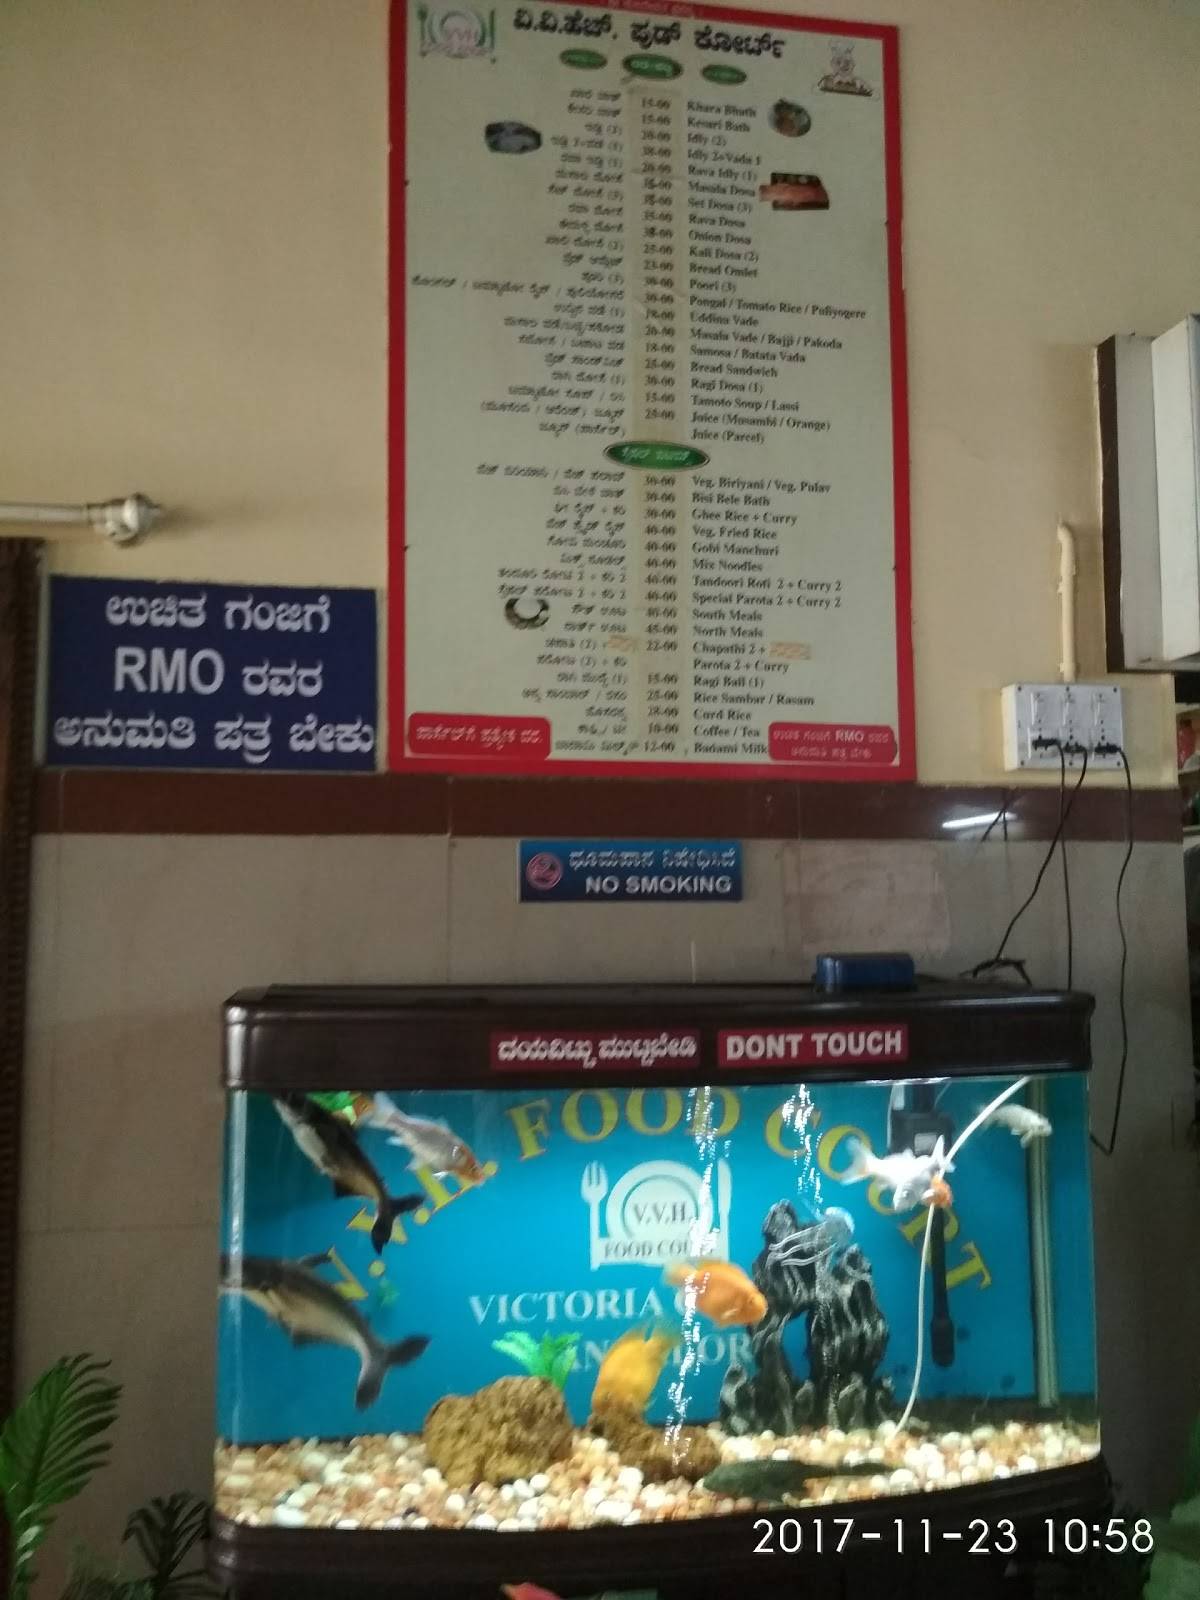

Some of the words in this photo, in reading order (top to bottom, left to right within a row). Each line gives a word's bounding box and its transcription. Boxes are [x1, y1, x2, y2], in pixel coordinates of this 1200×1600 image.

[711, 134, 726, 147] (2)
[736, 298, 775, 311] Tomato
[779, 301, 801, 312] Rice
[689, 345, 731, 358] Samosa
[690, 361, 722, 373] Bread
[725, 363, 778, 377] Sandwich
[734, 397, 761, 412] Soup
[691, 412, 718, 425] Juice
[785, 416, 830, 431] Orange)
[691, 428, 718, 442] Juice
[721, 430, 764, 444] (Parcel)
[691, 475, 714, 489] Veg.
[774, 479, 796, 492] Veg.
[743, 494, 770, 506] Bath
[724, 510, 748, 522] Rice
[762, 512, 798, 526] Curry
[692, 525, 715, 538] Veg.
[752, 527, 777, 539] Rice
[797, 579, 830, 593] Curry
[796, 595, 830, 609] Curry
[106, 591, 207, 628] ಉಚಿತ
[224, 593, 331, 634] ಗಂಜಿಗೆ
[692, 642, 745, 656] Chapathi
[115, 646, 224, 695] RMO
[242, 658, 323, 697] ರವರ
[693, 692, 717, 703] Rice
[726, 709, 751, 720] Rice
[53, 710, 196, 750] ಅನುಮತಿ
[214, 713, 272, 764] ಪತ್ರ
[290, 713, 374, 754] ಬೇಕು
[693, 725, 731, 737] Coffee
[741, 726, 759, 737] Tea
[835, 729, 864, 743] RMO
[586, 875, 619, 894] NO
[625, 875, 732, 894] SMOKING
[726, 1033, 803, 1061] DONT
[811, 1030, 902, 1058] TOUCH
[505, 1086, 742, 1162] FOOD
[468, 1288, 664, 1325] VICTORIA
